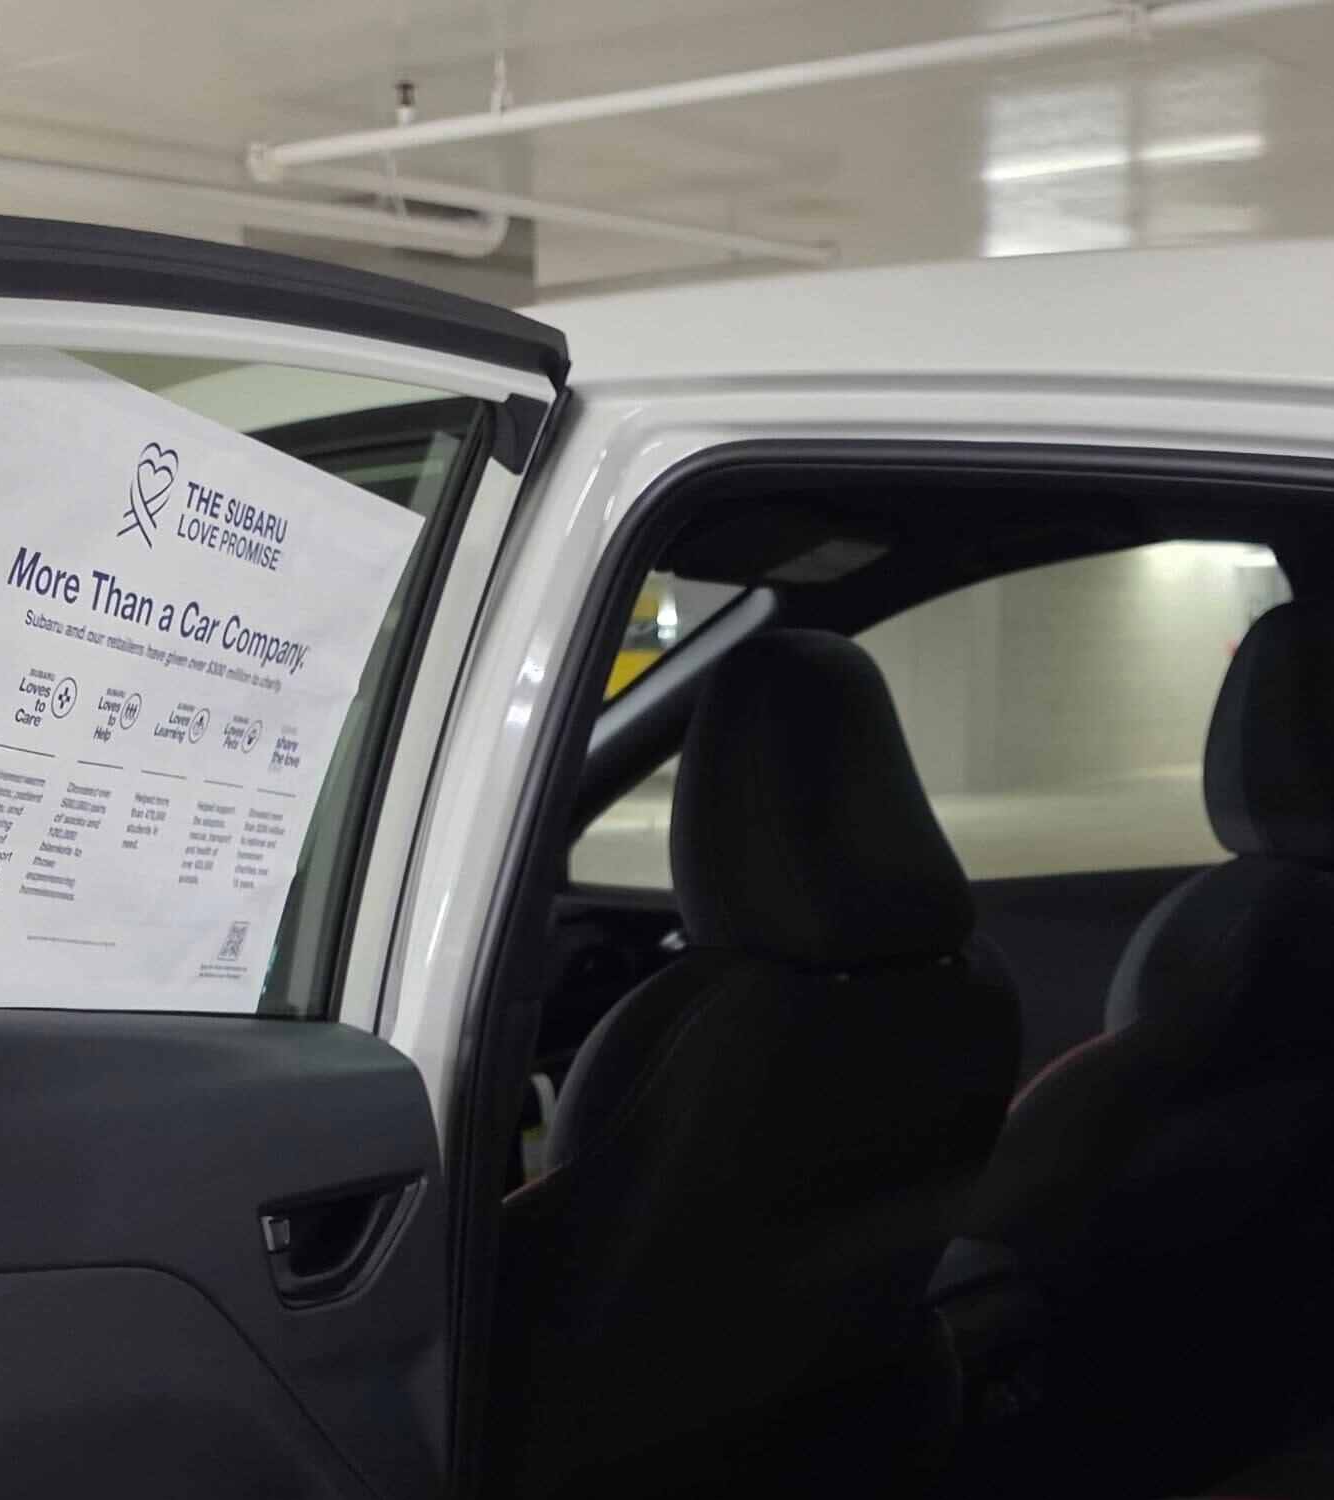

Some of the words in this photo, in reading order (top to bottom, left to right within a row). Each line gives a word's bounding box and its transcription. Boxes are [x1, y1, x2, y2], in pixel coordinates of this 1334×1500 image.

[186, 481, 223, 519] THE
[225, 498, 287, 543] SUBARU
[177, 514, 219, 549] LOVE
[219, 532, 281, 571] PROMISE
[7, 547, 80, 604] More
[91, 570, 153, 626] Than
[158, 604, 175, 632] a
[180, 601, 220, 645] Car
[25, 609, 64, 634] Subaru
[66, 622, 86, 640] and
[87, 629, 104, 645] our
[19, 678, 51, 698] Loves
[34, 699, 46, 713] to
[98, 696, 121, 713] Loves
[14, 708, 41, 727] Care
[108, 714, 116, 726] to
[169, 711, 190, 726] Loves
[94, 726, 111, 743] Help
[154, 723, 186, 744] Learning
[224, 723, 244, 738] Loves
[276, 736, 298, 752] share
